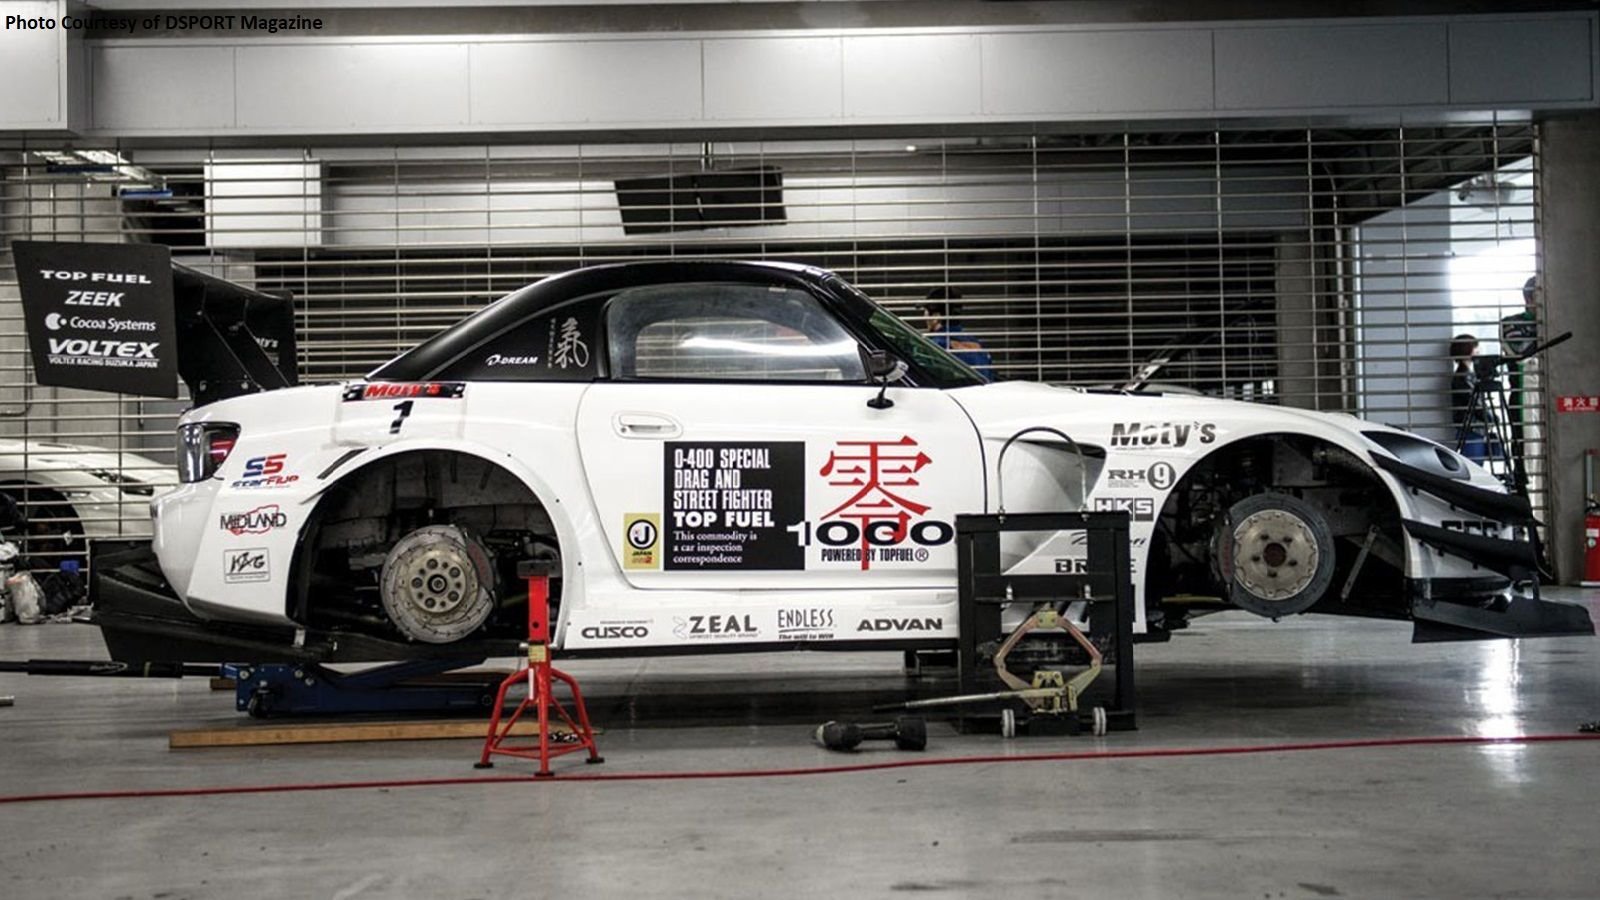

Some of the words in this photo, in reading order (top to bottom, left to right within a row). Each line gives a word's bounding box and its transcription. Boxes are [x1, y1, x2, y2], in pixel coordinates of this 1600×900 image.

[40, 270, 88, 280] TOP
[91, 272, 151, 284] FUEL
[64, 290, 125, 307] ZEEK
[70, 316, 106, 329] Cocoa
[108, 318, 156, 332] Systems
[48, 338, 160, 358] VOLTEX
[389, 400, 414, 434] 1
[1110, 422, 1216, 448] Moty's
[720, 448, 771, 469] SPECIAL
[674, 469, 709, 489] DRAG
[715, 469, 740, 489] AND
[673, 490, 718, 509] STREET
[722, 490, 773, 509] FIGHTER
[1095, 499, 1153, 515] HKS
[220, 513, 287, 529] MIDLAND
[673, 511, 717, 527] TOP
[725, 511, 775, 527] FUEL
[673, 531, 694, 540] This
[696, 530, 748, 543] commodity
[750, 530, 757, 540] is
[697, 543, 743, 554] inspection
[821, 548, 862, 561] POWERED
[673, 554, 742, 565] correspondence
[689, 615, 757, 634] ZEAL
[778, 609, 833, 628] ENDLESS
[857, 618, 943, 632] ADVAN
[582, 626, 648, 639] CUSCO
